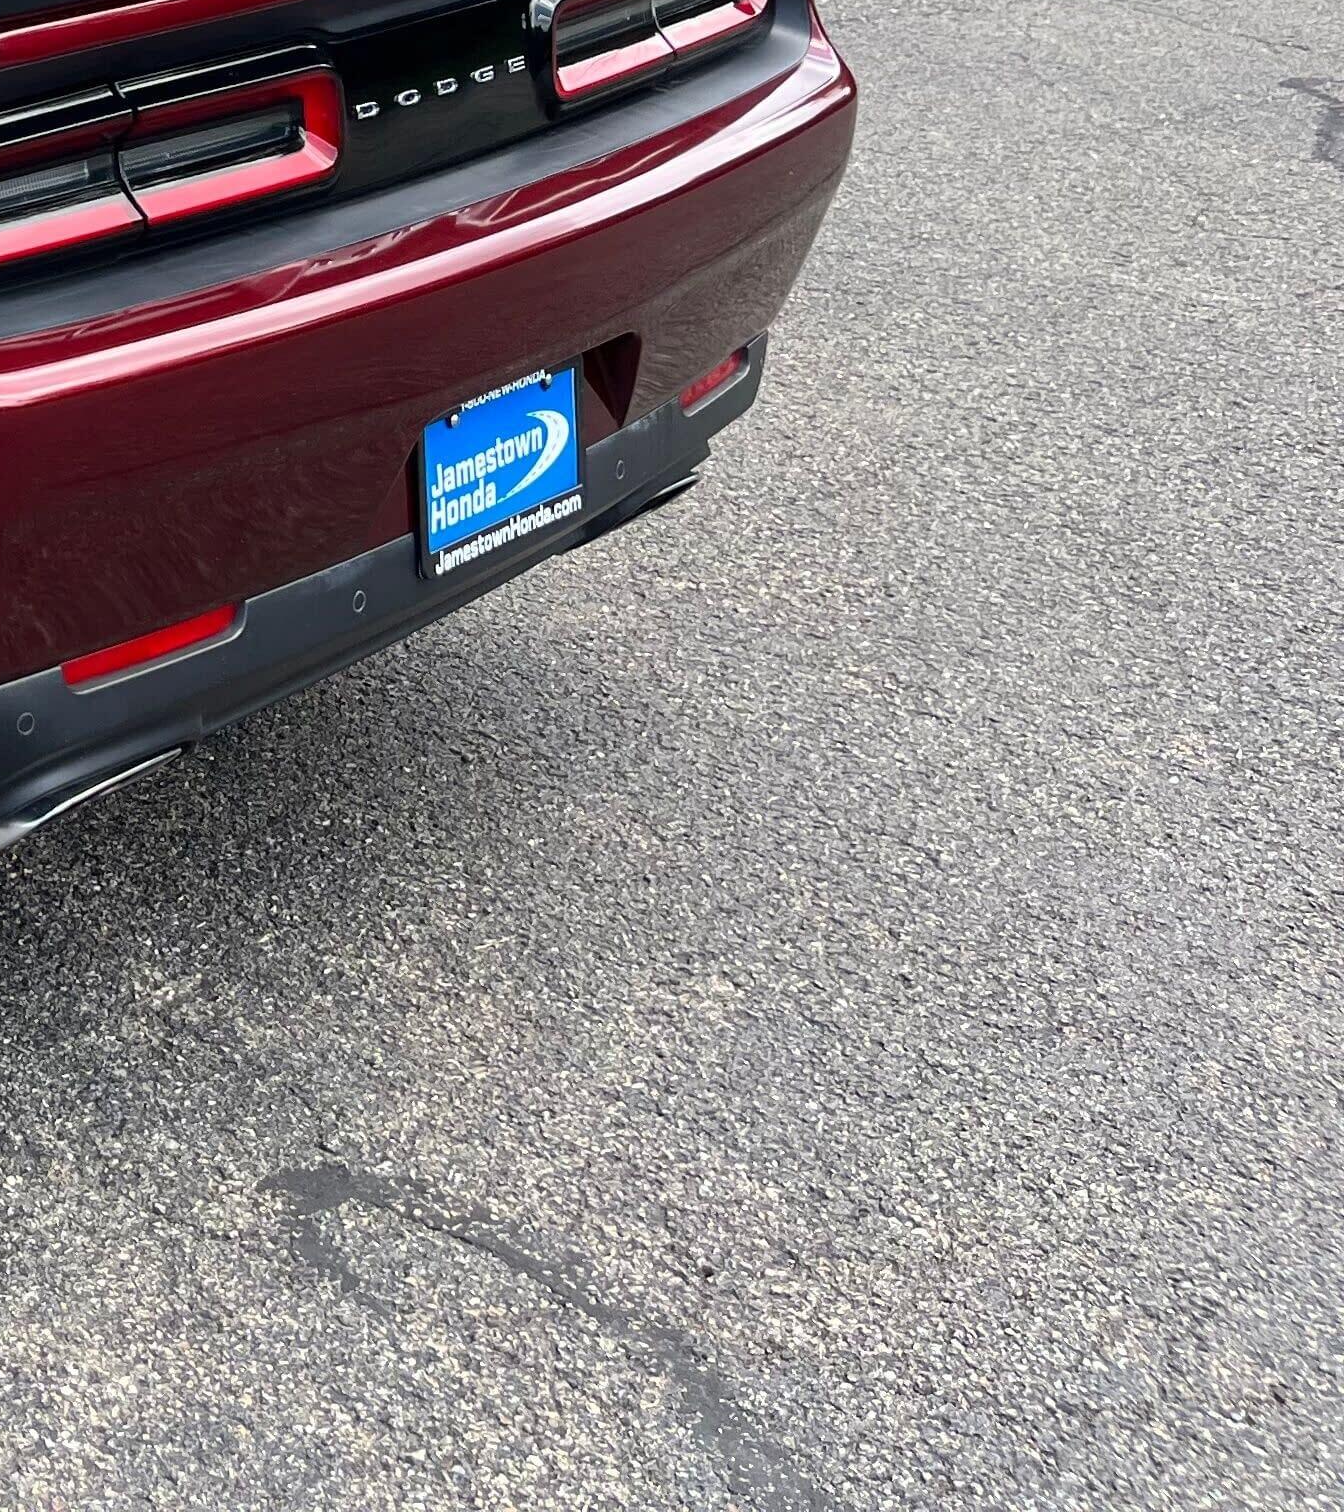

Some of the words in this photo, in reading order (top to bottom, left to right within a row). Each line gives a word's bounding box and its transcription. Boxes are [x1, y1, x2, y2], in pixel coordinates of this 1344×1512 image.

[353, 55, 527, 120] DODGE
[431, 426, 543, 499] Jamestown
[430, 479, 498, 534] Honda
[435, 493, 583, 576] JamestownHonda.com
